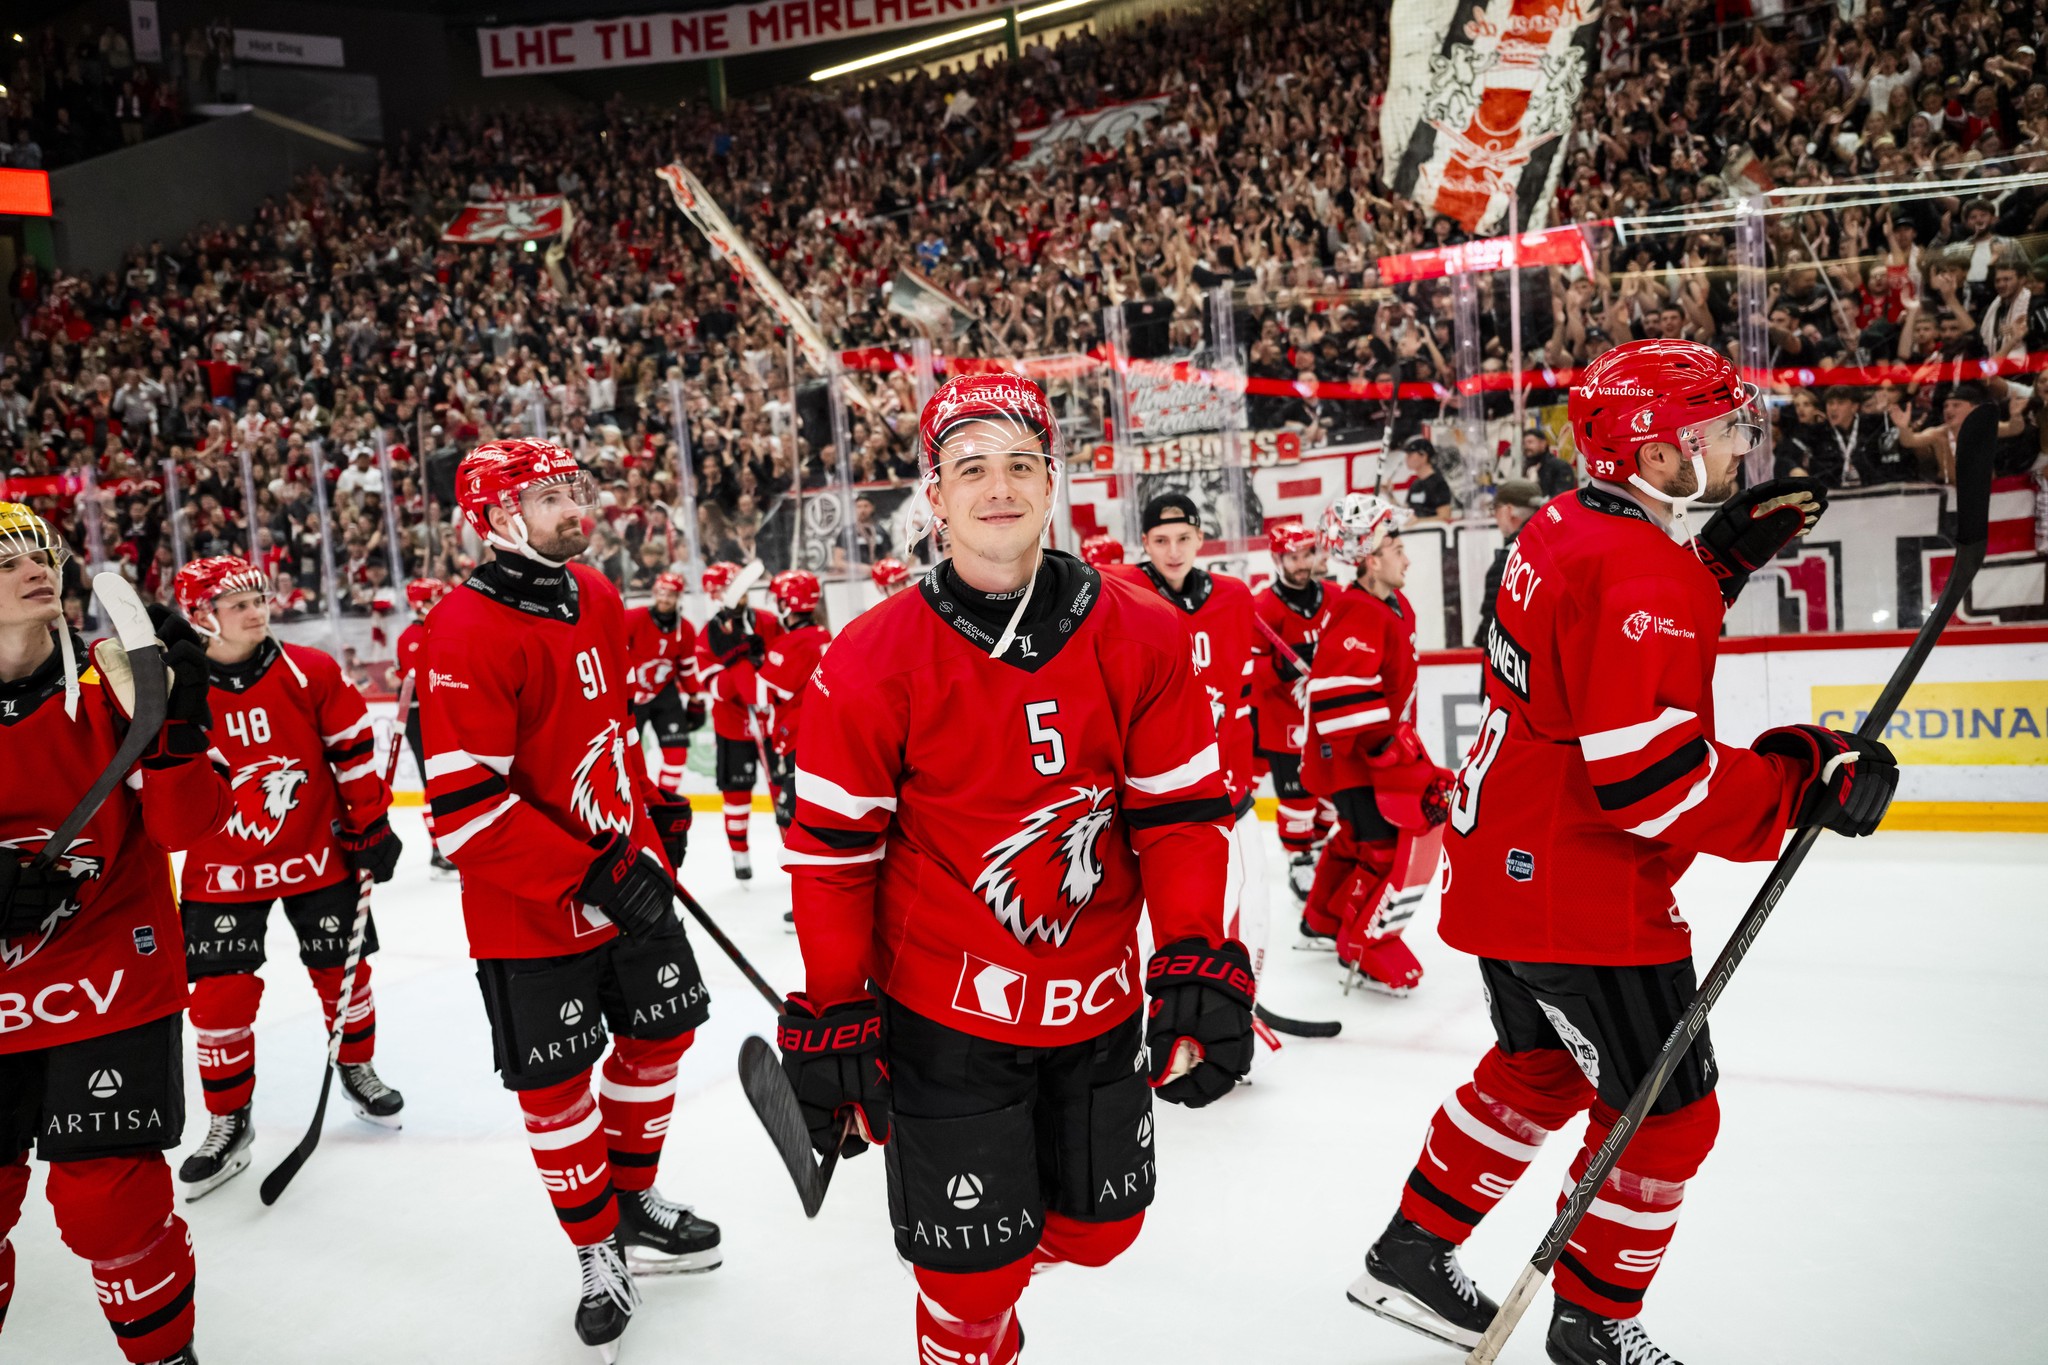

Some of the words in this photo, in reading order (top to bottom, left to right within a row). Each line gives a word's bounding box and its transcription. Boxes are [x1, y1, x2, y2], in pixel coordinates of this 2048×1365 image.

[490, 28, 576, 69] LHC
[594, 22, 652, 60] TU
[671, 14, 729, 54] NE
[748, 0, 997, 45] MARCHE
[960, 385, 1037, 402] vaudoise
[1598, 384, 1654, 397] vaudoise
[1596, 460, 1615, 475] 29
[533, 577, 563, 587] BAU
[985, 586, 1030, 600] BAUE
[1070, 581, 1091, 614] SAFEGUARD
[1505, 551, 1542, 612] BCV
[1076, 593, 1092, 616] GLOBAL
[953, 621, 979, 641] GLOBAL
[955, 615, 995, 645] SAFEGUARD
[1658, 617, 1675, 627] LHC
[576, 647, 607, 700] 91
[225, 707, 272, 747] 48
[1024, 699, 1067, 777] 5
[1819, 706, 2048, 740] CRDINA
[253, 847, 330, 889] BCV
[186, 938, 259, 956] ARTISA
[301, 937, 368, 951] ARTI
[0, 969, 124, 1034] BCV
[633, 982, 708, 1026] ARTISA
[1662, 1020, 1685, 1052] OKSANEN
[48, 1108, 162, 1135] ARTISA
[1099, 1160, 1155, 1203] ART
[914, 1208, 1035, 1249] ARTISA
